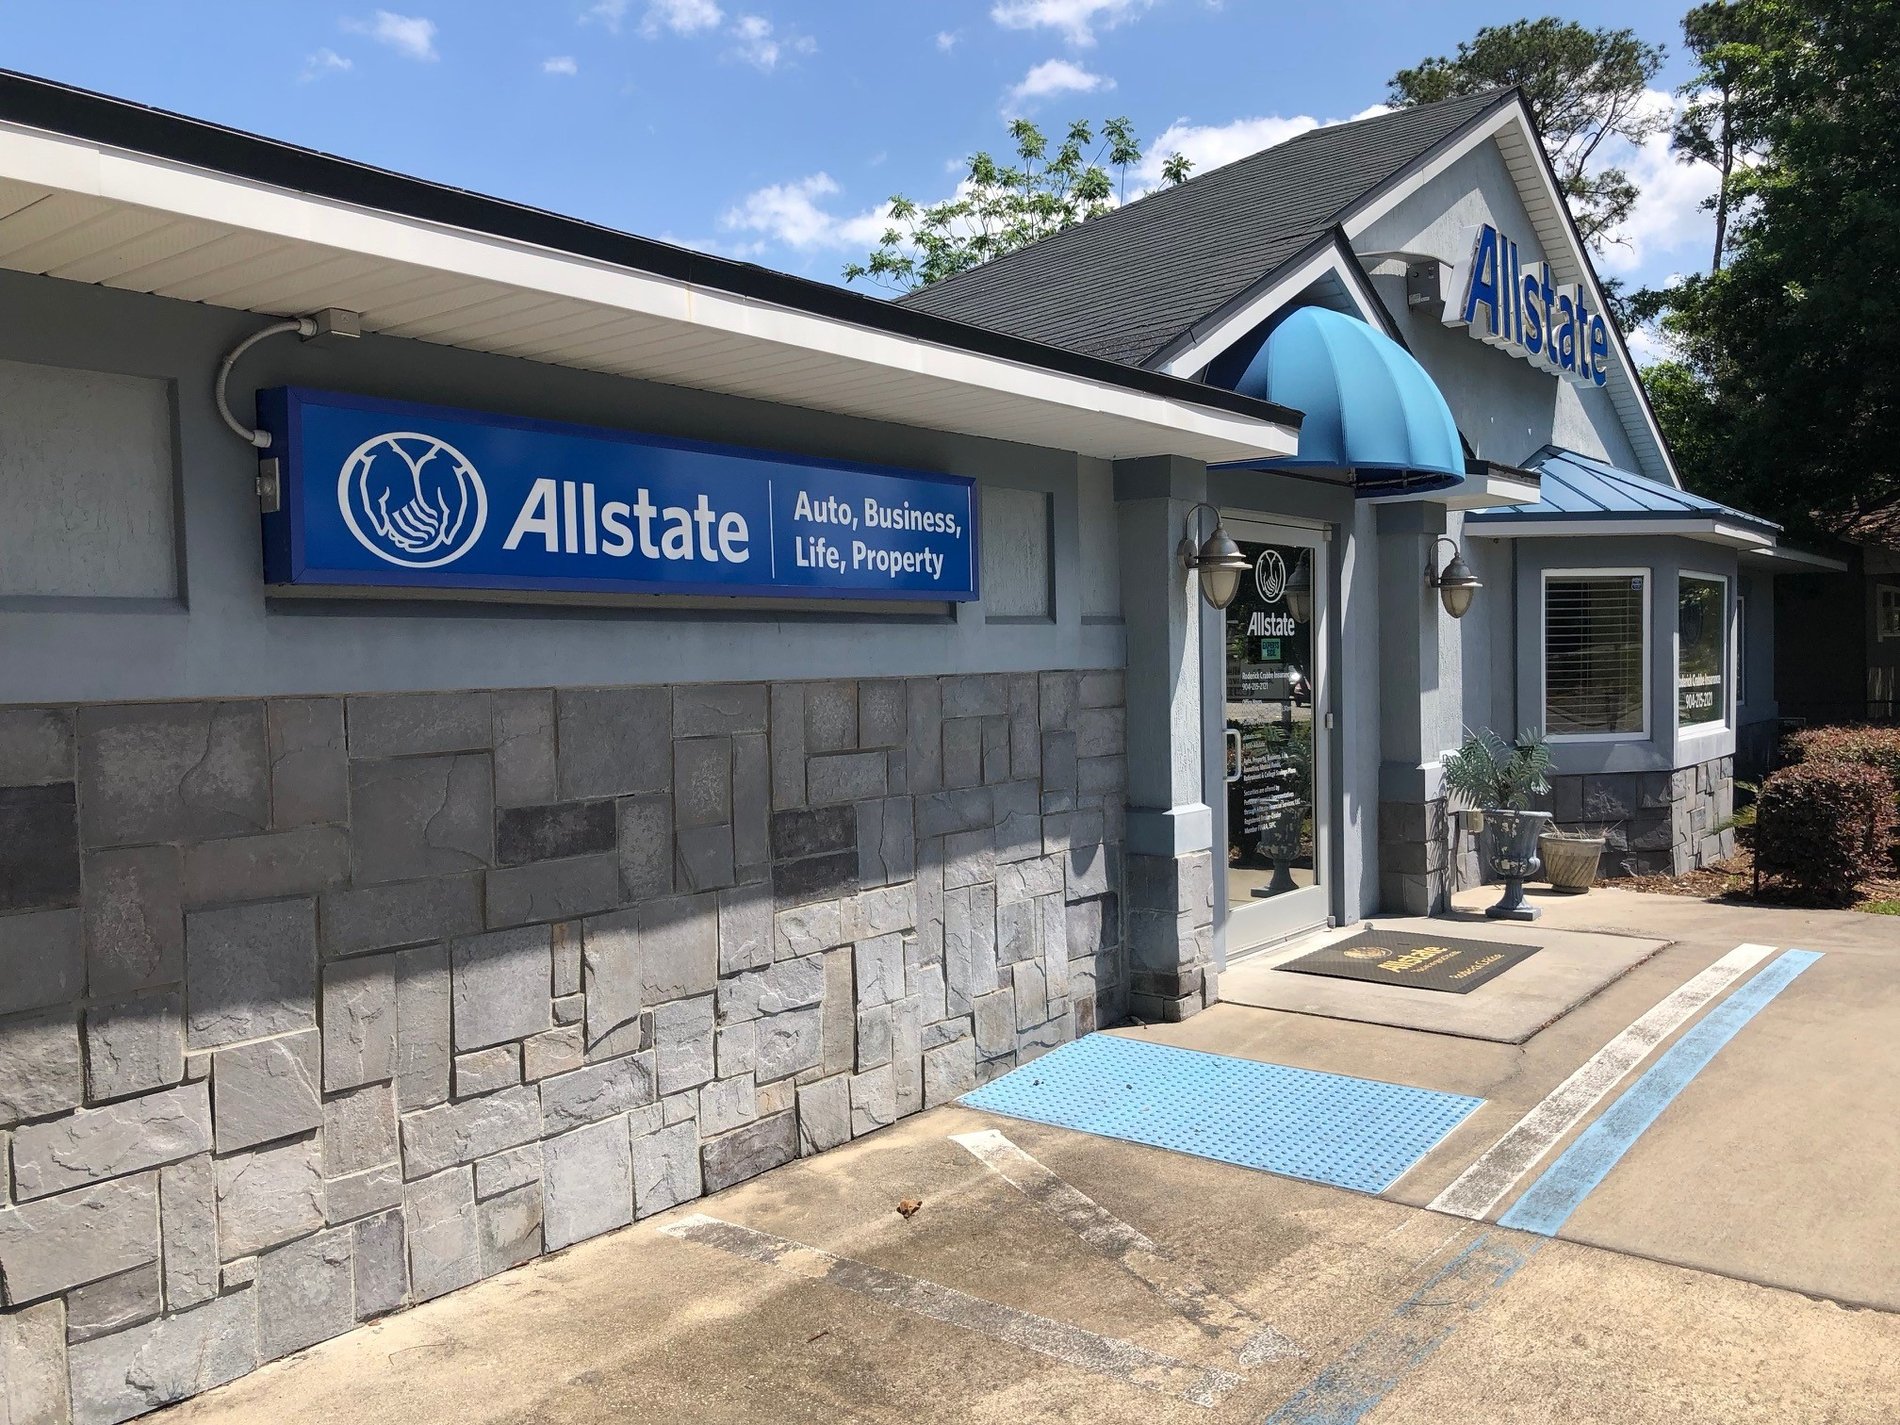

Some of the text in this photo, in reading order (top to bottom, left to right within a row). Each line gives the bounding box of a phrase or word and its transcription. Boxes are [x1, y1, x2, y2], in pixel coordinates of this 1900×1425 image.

[1463, 222, 1608, 388] Allstate
[502, 478, 751, 564] Allstate
[794, 490, 962, 539] Auto, Business,
[795, 536, 944, 581] Life, Property
[1246, 612, 1295, 636] Allstate
[1241, 671, 1260, 680] Roderick
[1679, 673, 1692, 688] oderick
